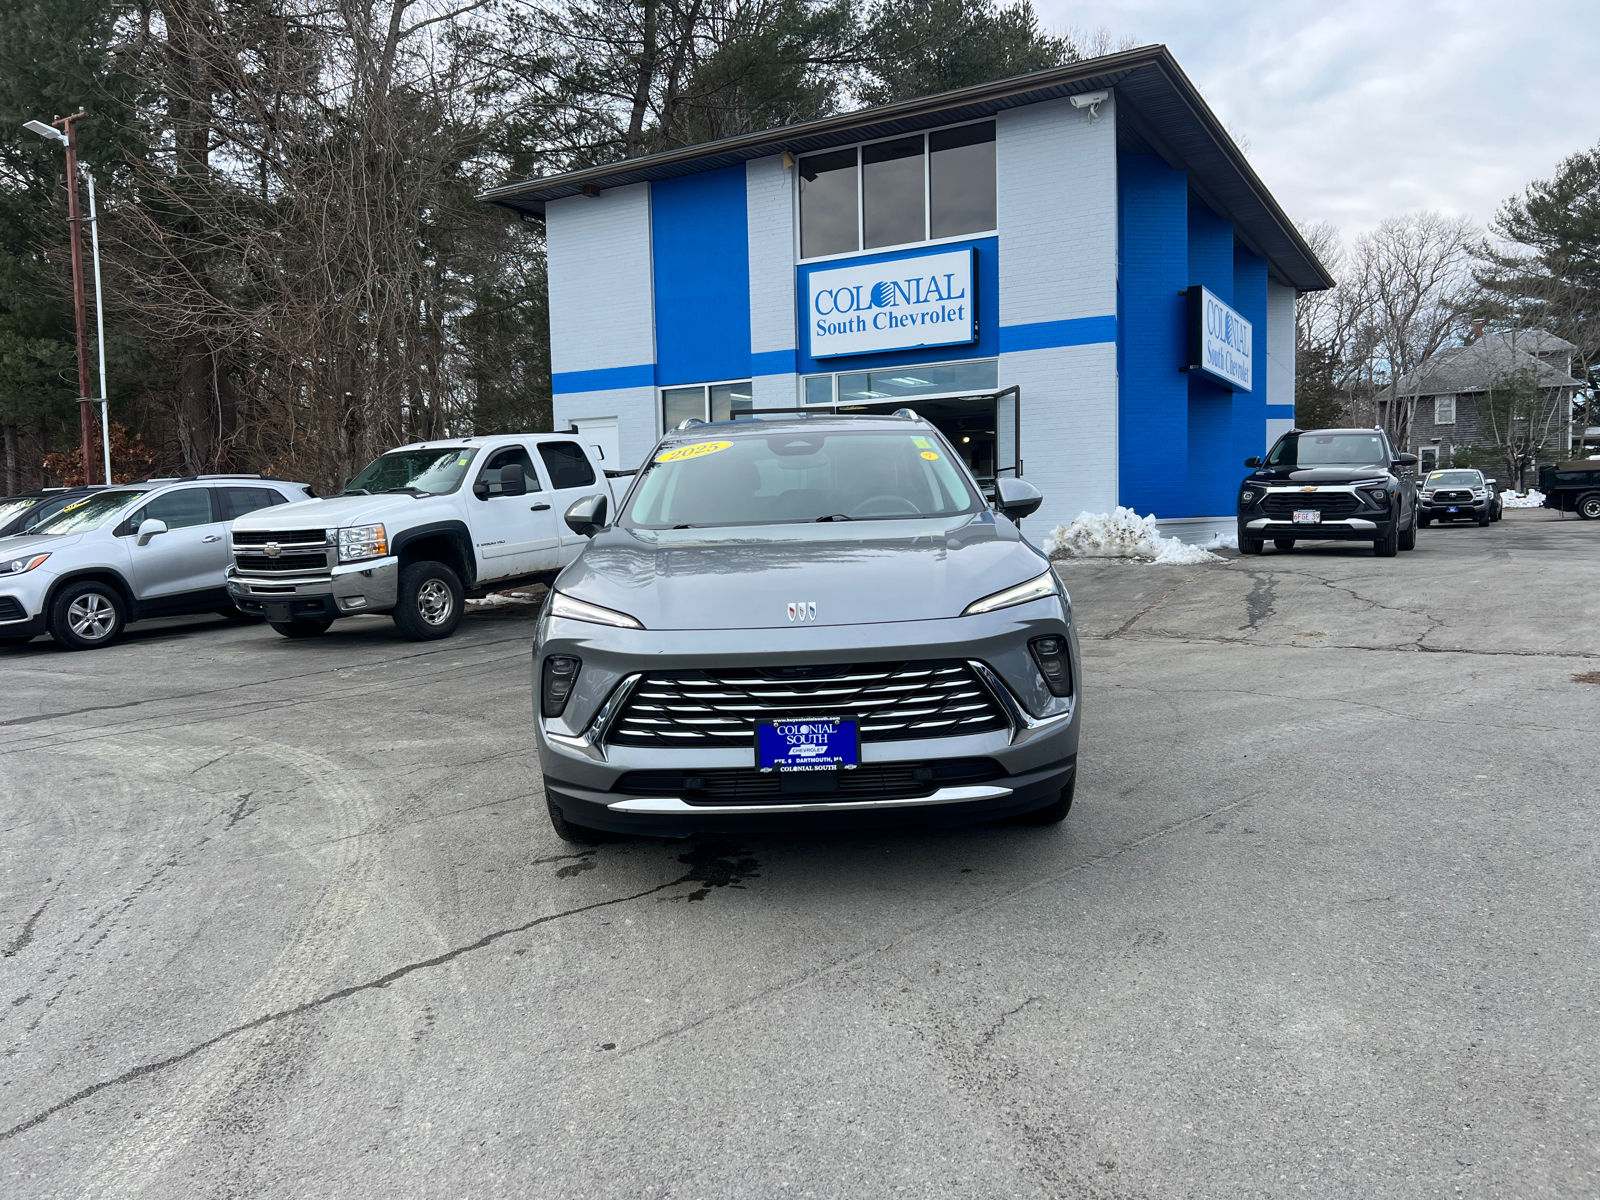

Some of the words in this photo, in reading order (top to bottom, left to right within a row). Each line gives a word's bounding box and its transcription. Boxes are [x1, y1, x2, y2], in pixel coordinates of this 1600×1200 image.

[815, 273, 965, 315] COLONIAL
[816, 315, 867, 337] South
[873, 304, 965, 330] Chevrolet
[1207, 299, 1249, 358] COLONIAL
[1207, 339, 1225, 371] South
[1226, 350, 1249, 384] Chevrolet
[669, 442, 721, 461] 2025
[777, 723, 838, 736] COLONIAL
[786, 734, 829, 745] SOUTH
[780, 764, 814, 772] COLONIAL
[796, 756, 833, 764] DARTMOUTH,
